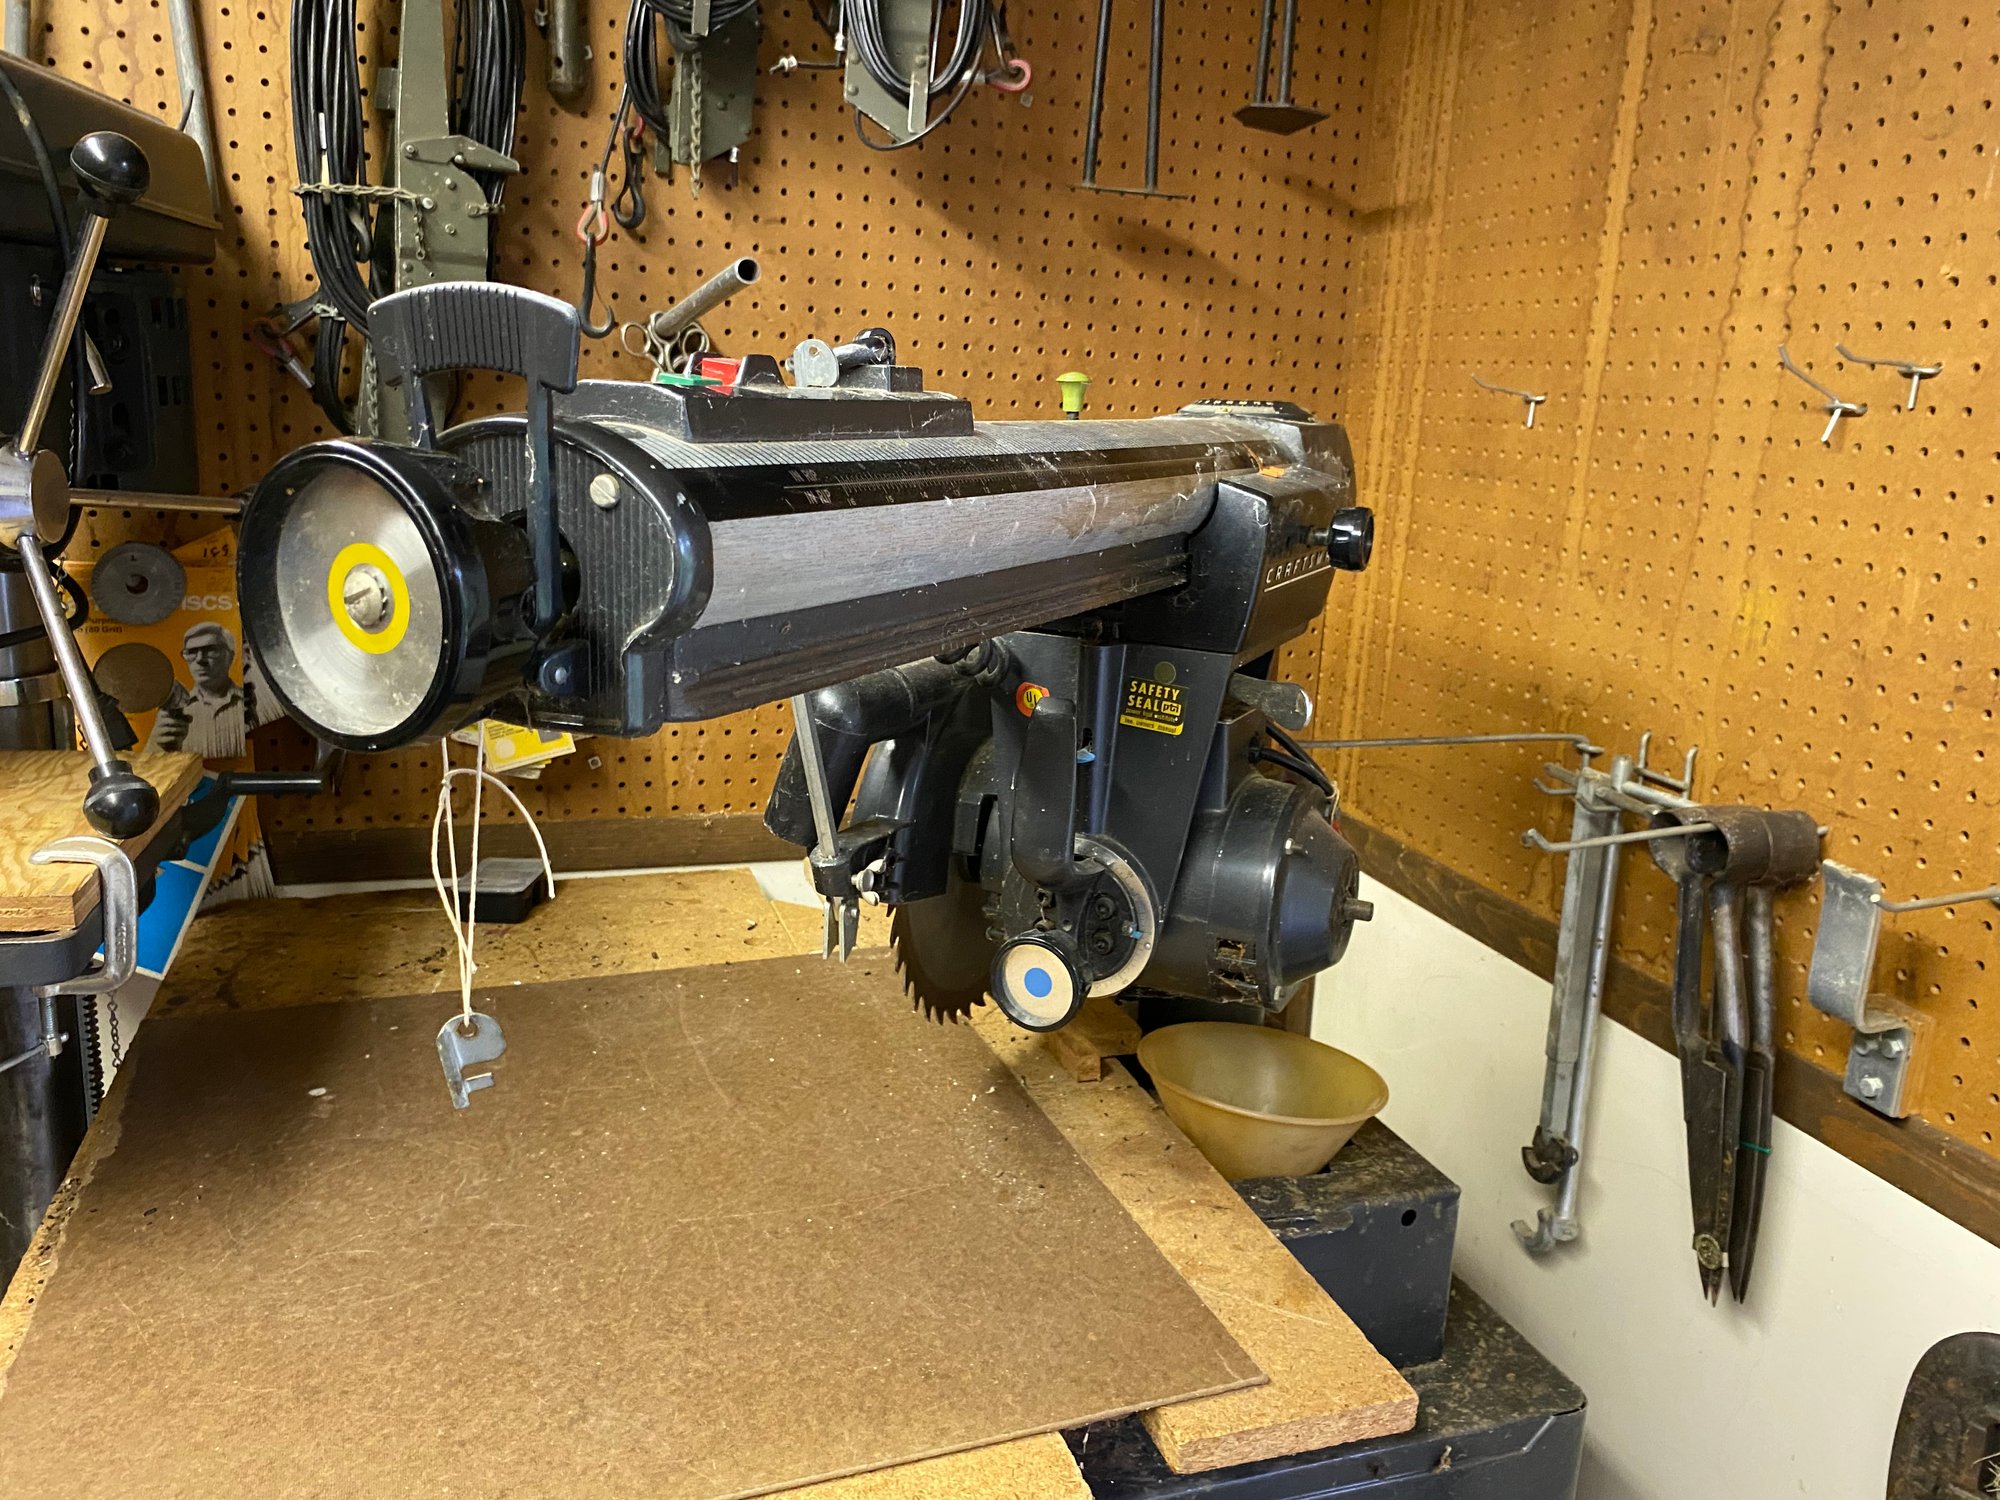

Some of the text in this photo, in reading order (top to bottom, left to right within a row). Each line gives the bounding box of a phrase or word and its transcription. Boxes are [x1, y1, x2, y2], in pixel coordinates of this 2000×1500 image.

[1266, 551, 1330, 584] CRAFTSMA
[182, 594, 234, 611] ISCS
[1129, 680, 1180, 701] SAFETY
[1127, 694, 1159, 712] SEAL
